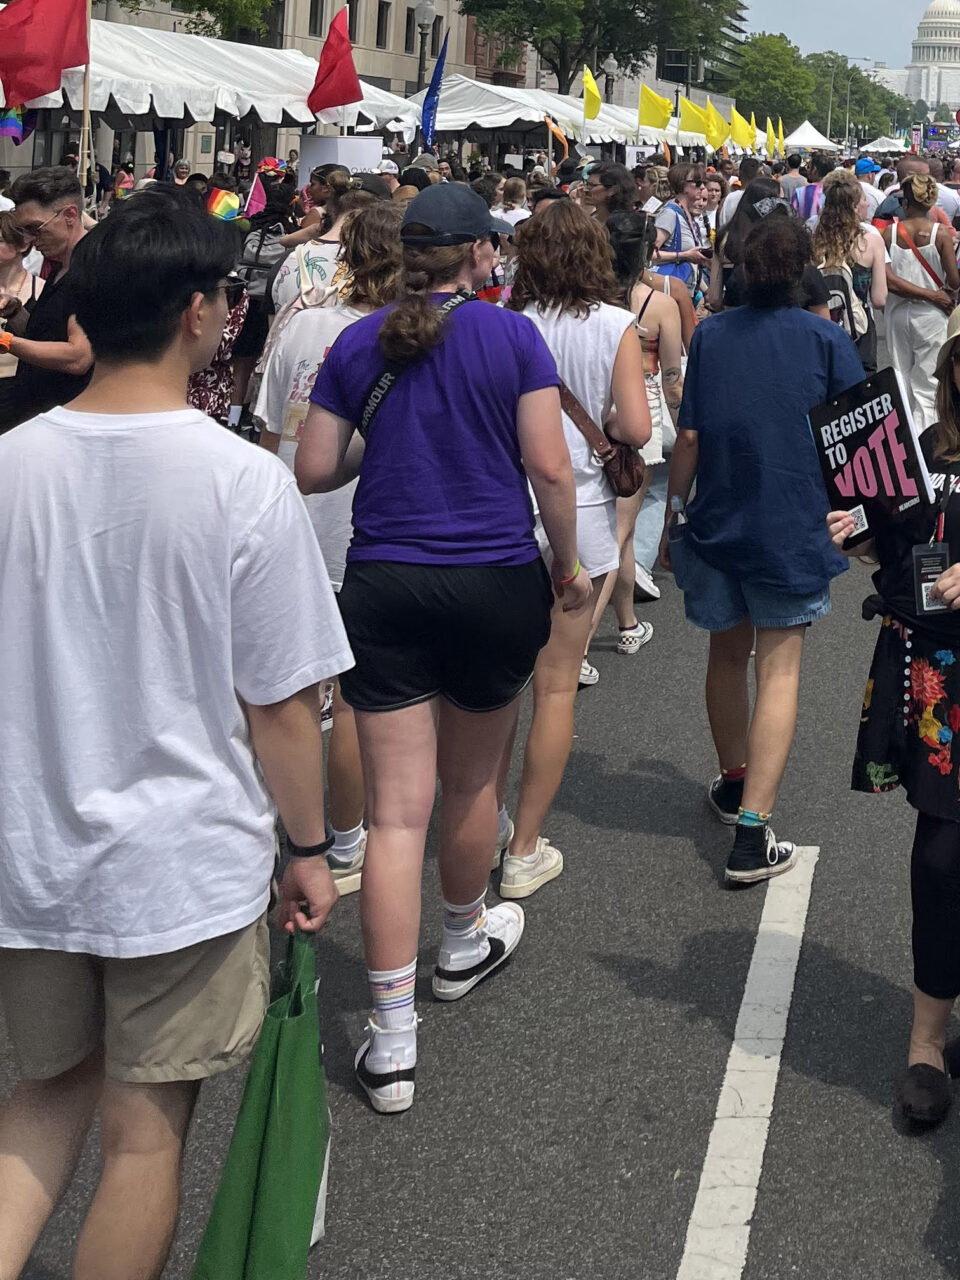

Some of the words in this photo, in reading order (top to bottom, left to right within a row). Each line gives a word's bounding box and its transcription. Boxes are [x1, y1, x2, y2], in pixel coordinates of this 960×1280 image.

[361, 372, 395, 433] ARMOUR
[820, 393, 893, 447] REGISTER
[825, 442, 848, 470] TO
[833, 408, 919, 498] VOTE
